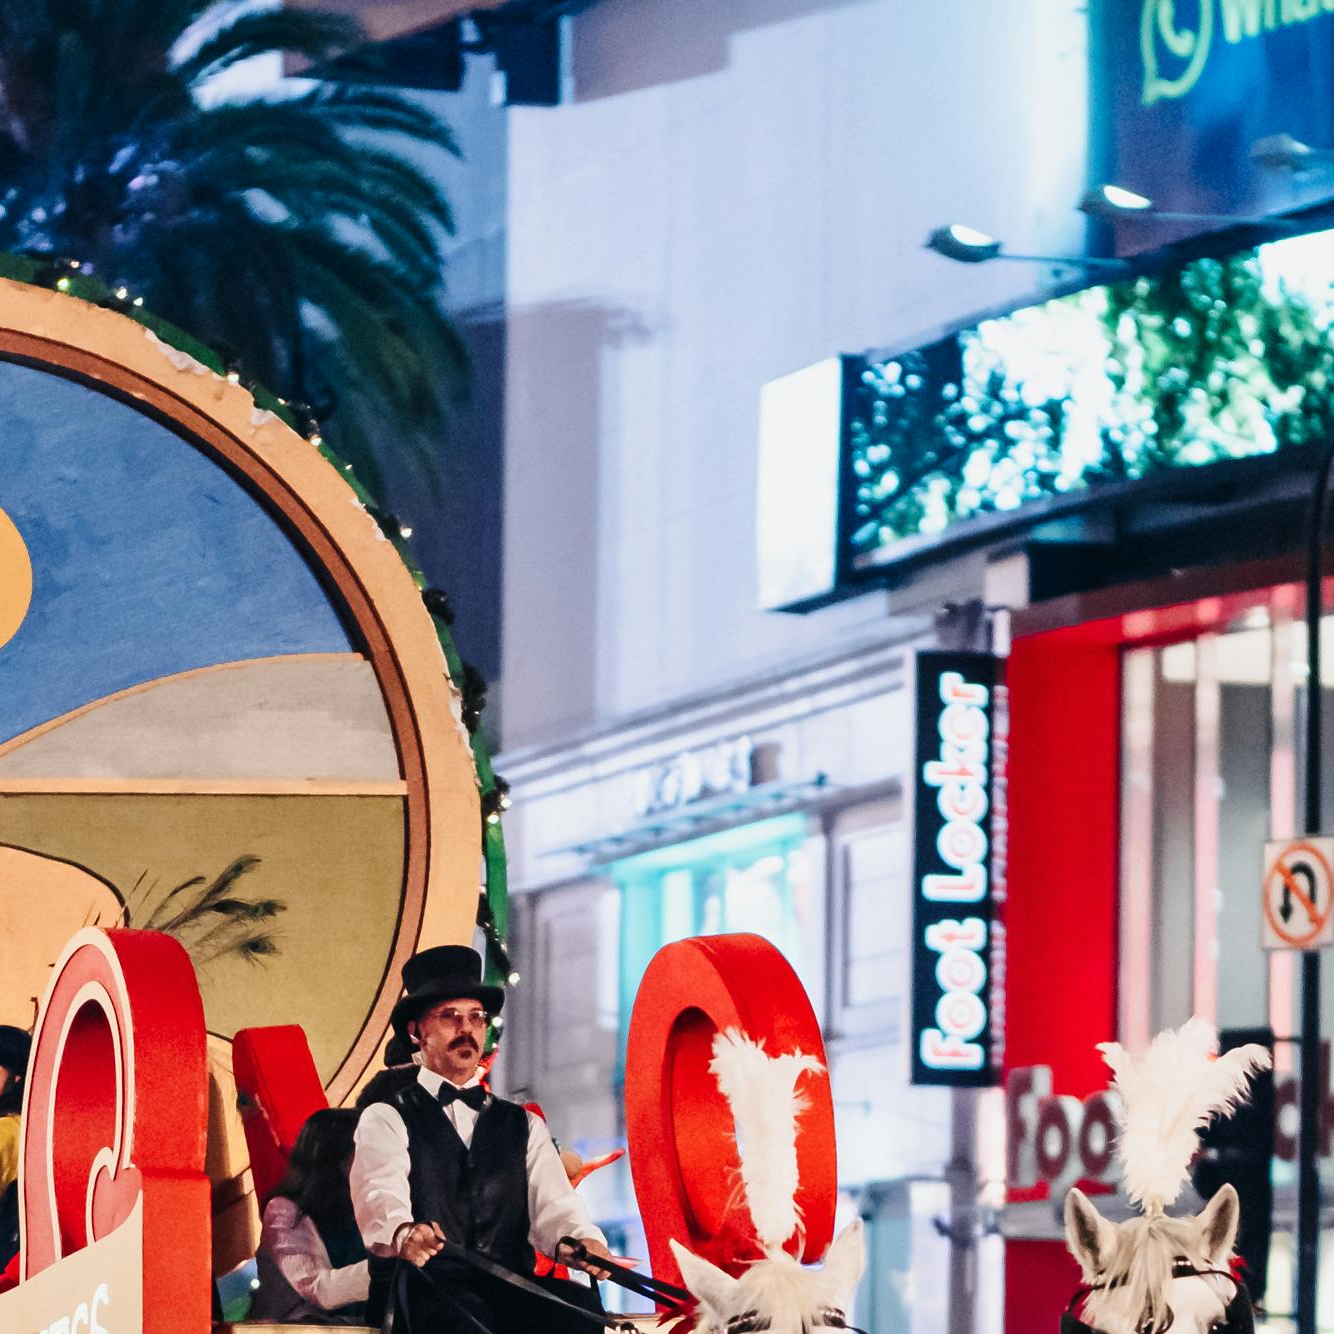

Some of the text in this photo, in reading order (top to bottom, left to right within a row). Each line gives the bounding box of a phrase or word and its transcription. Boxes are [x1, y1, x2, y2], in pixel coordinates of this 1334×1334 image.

[919, 670, 989, 1070] Foot Locker
[1005, 1066, 1117, 1186] Foo
